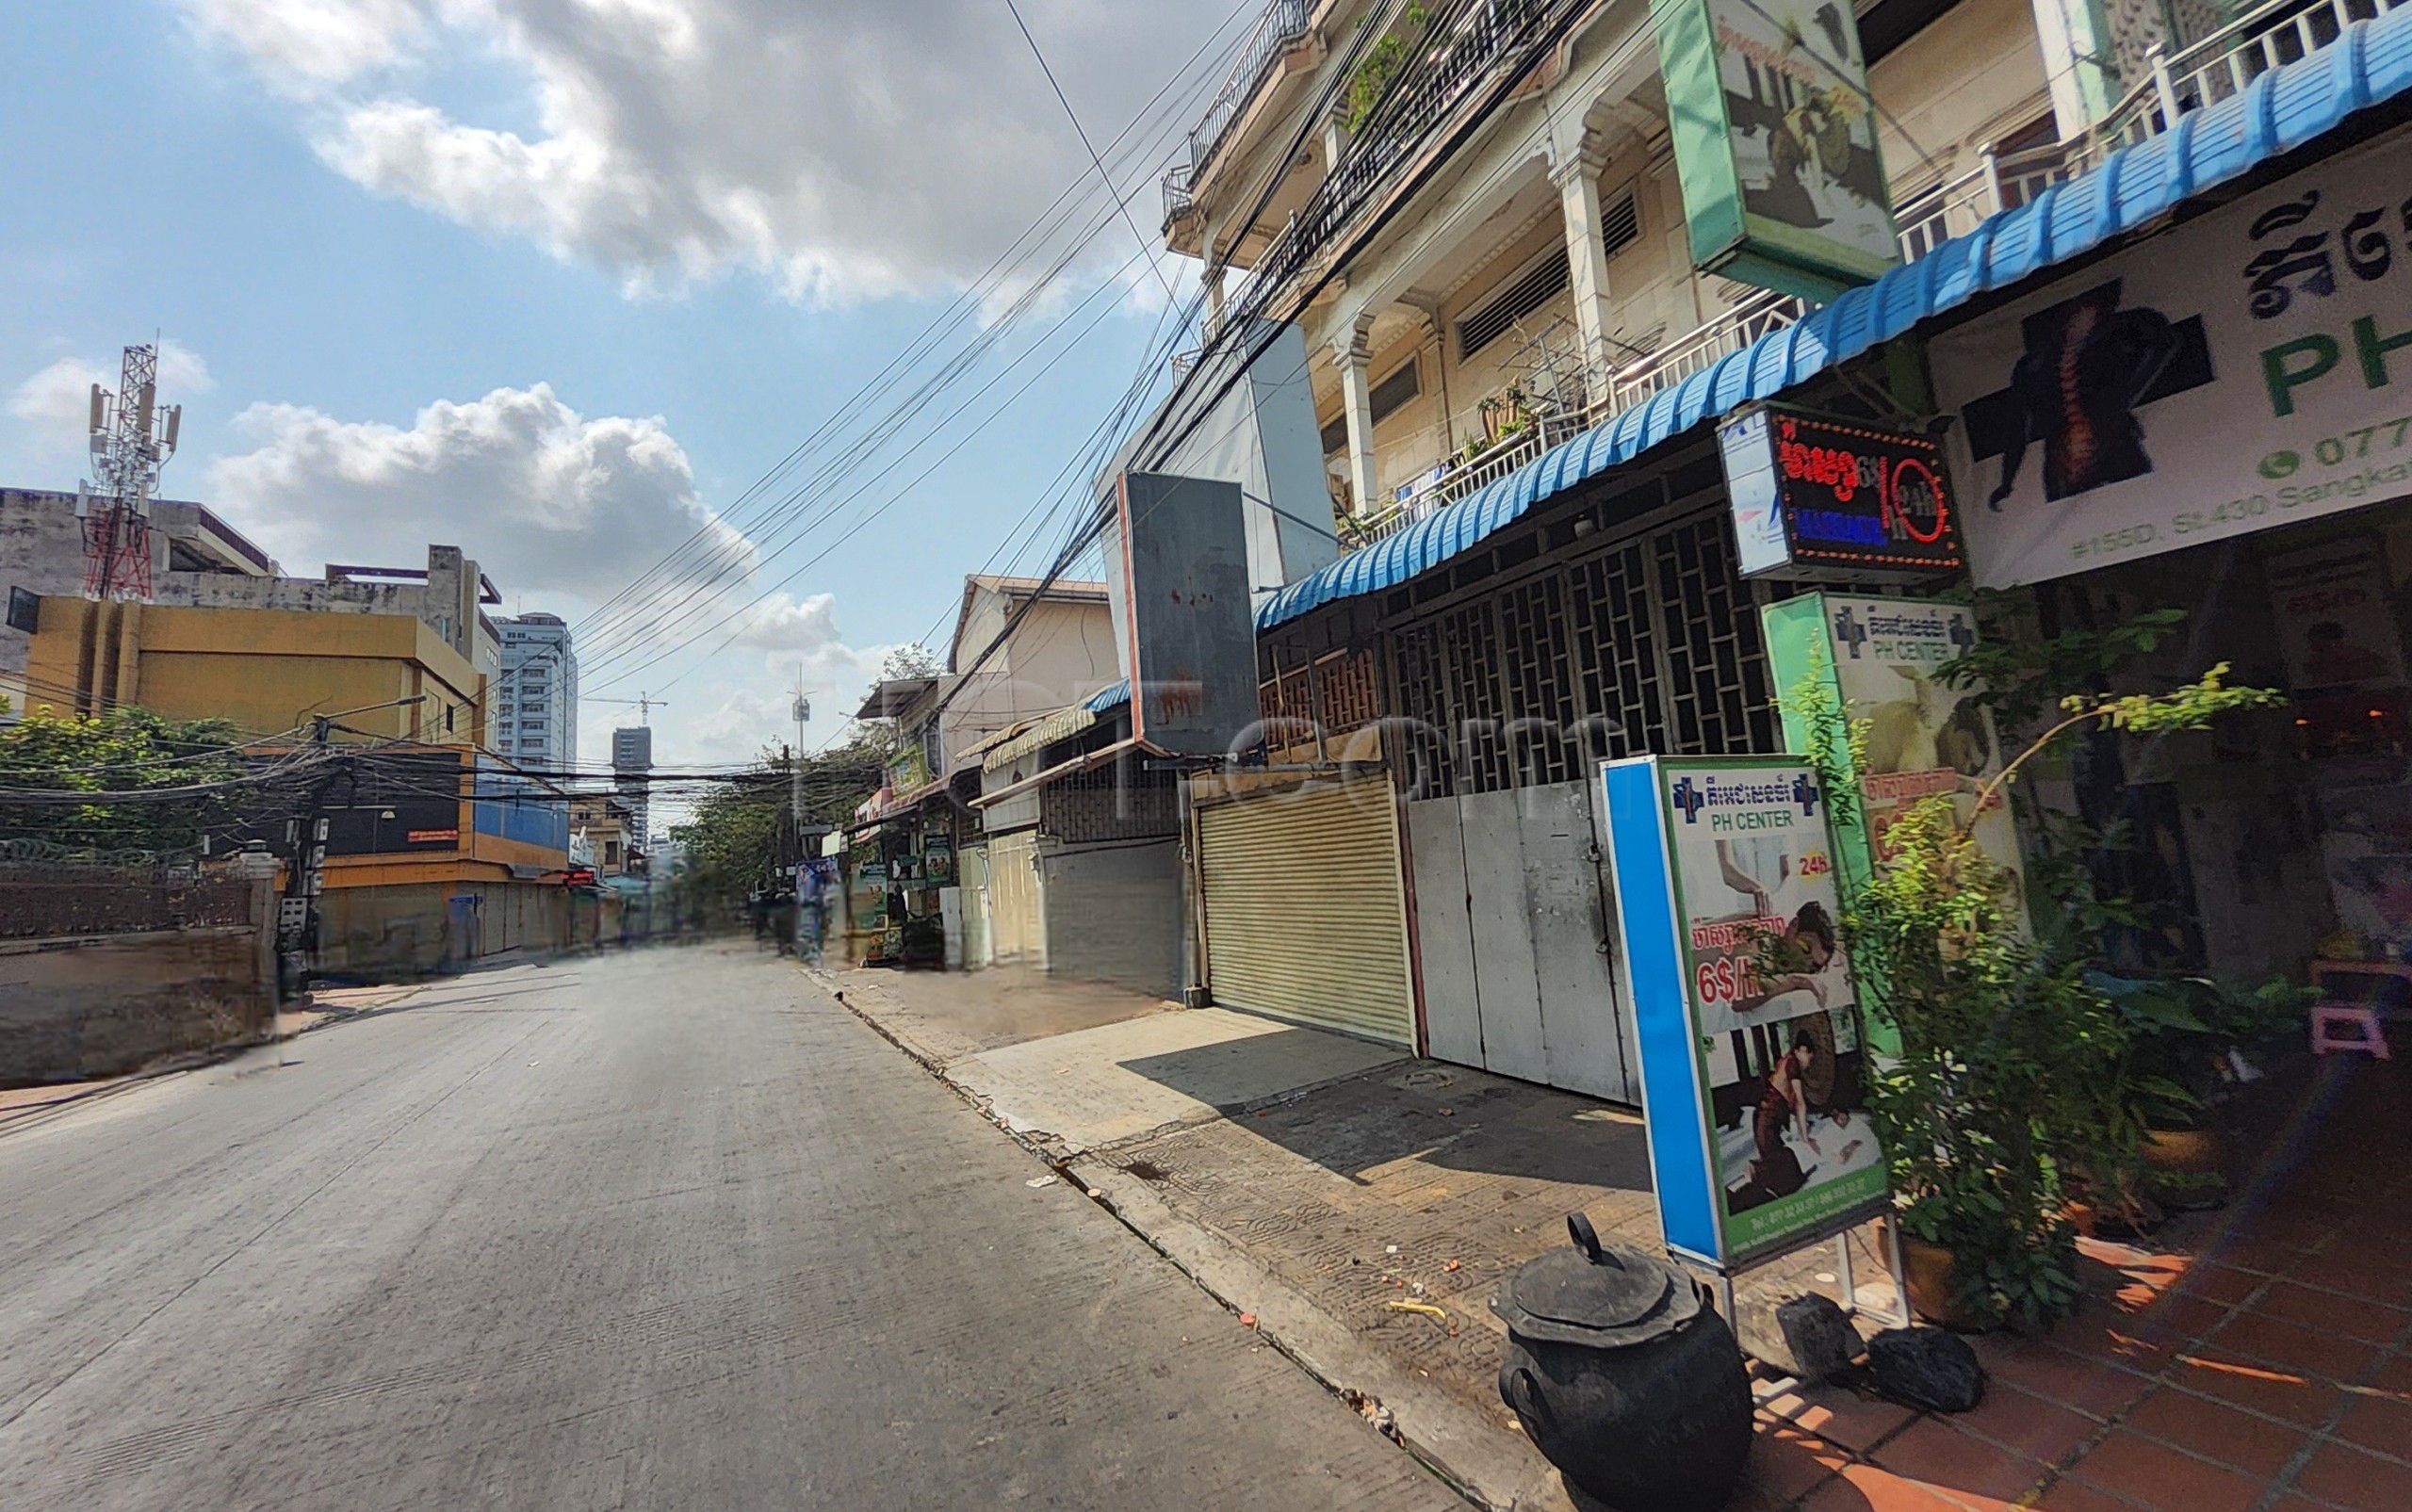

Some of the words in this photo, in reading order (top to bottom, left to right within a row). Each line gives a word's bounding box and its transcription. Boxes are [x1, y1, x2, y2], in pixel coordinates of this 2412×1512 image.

[2276, 459, 2412, 508] Sangka
[1711, 814, 1733, 832] PH
[1736, 810, 1794, 830] CENTER
